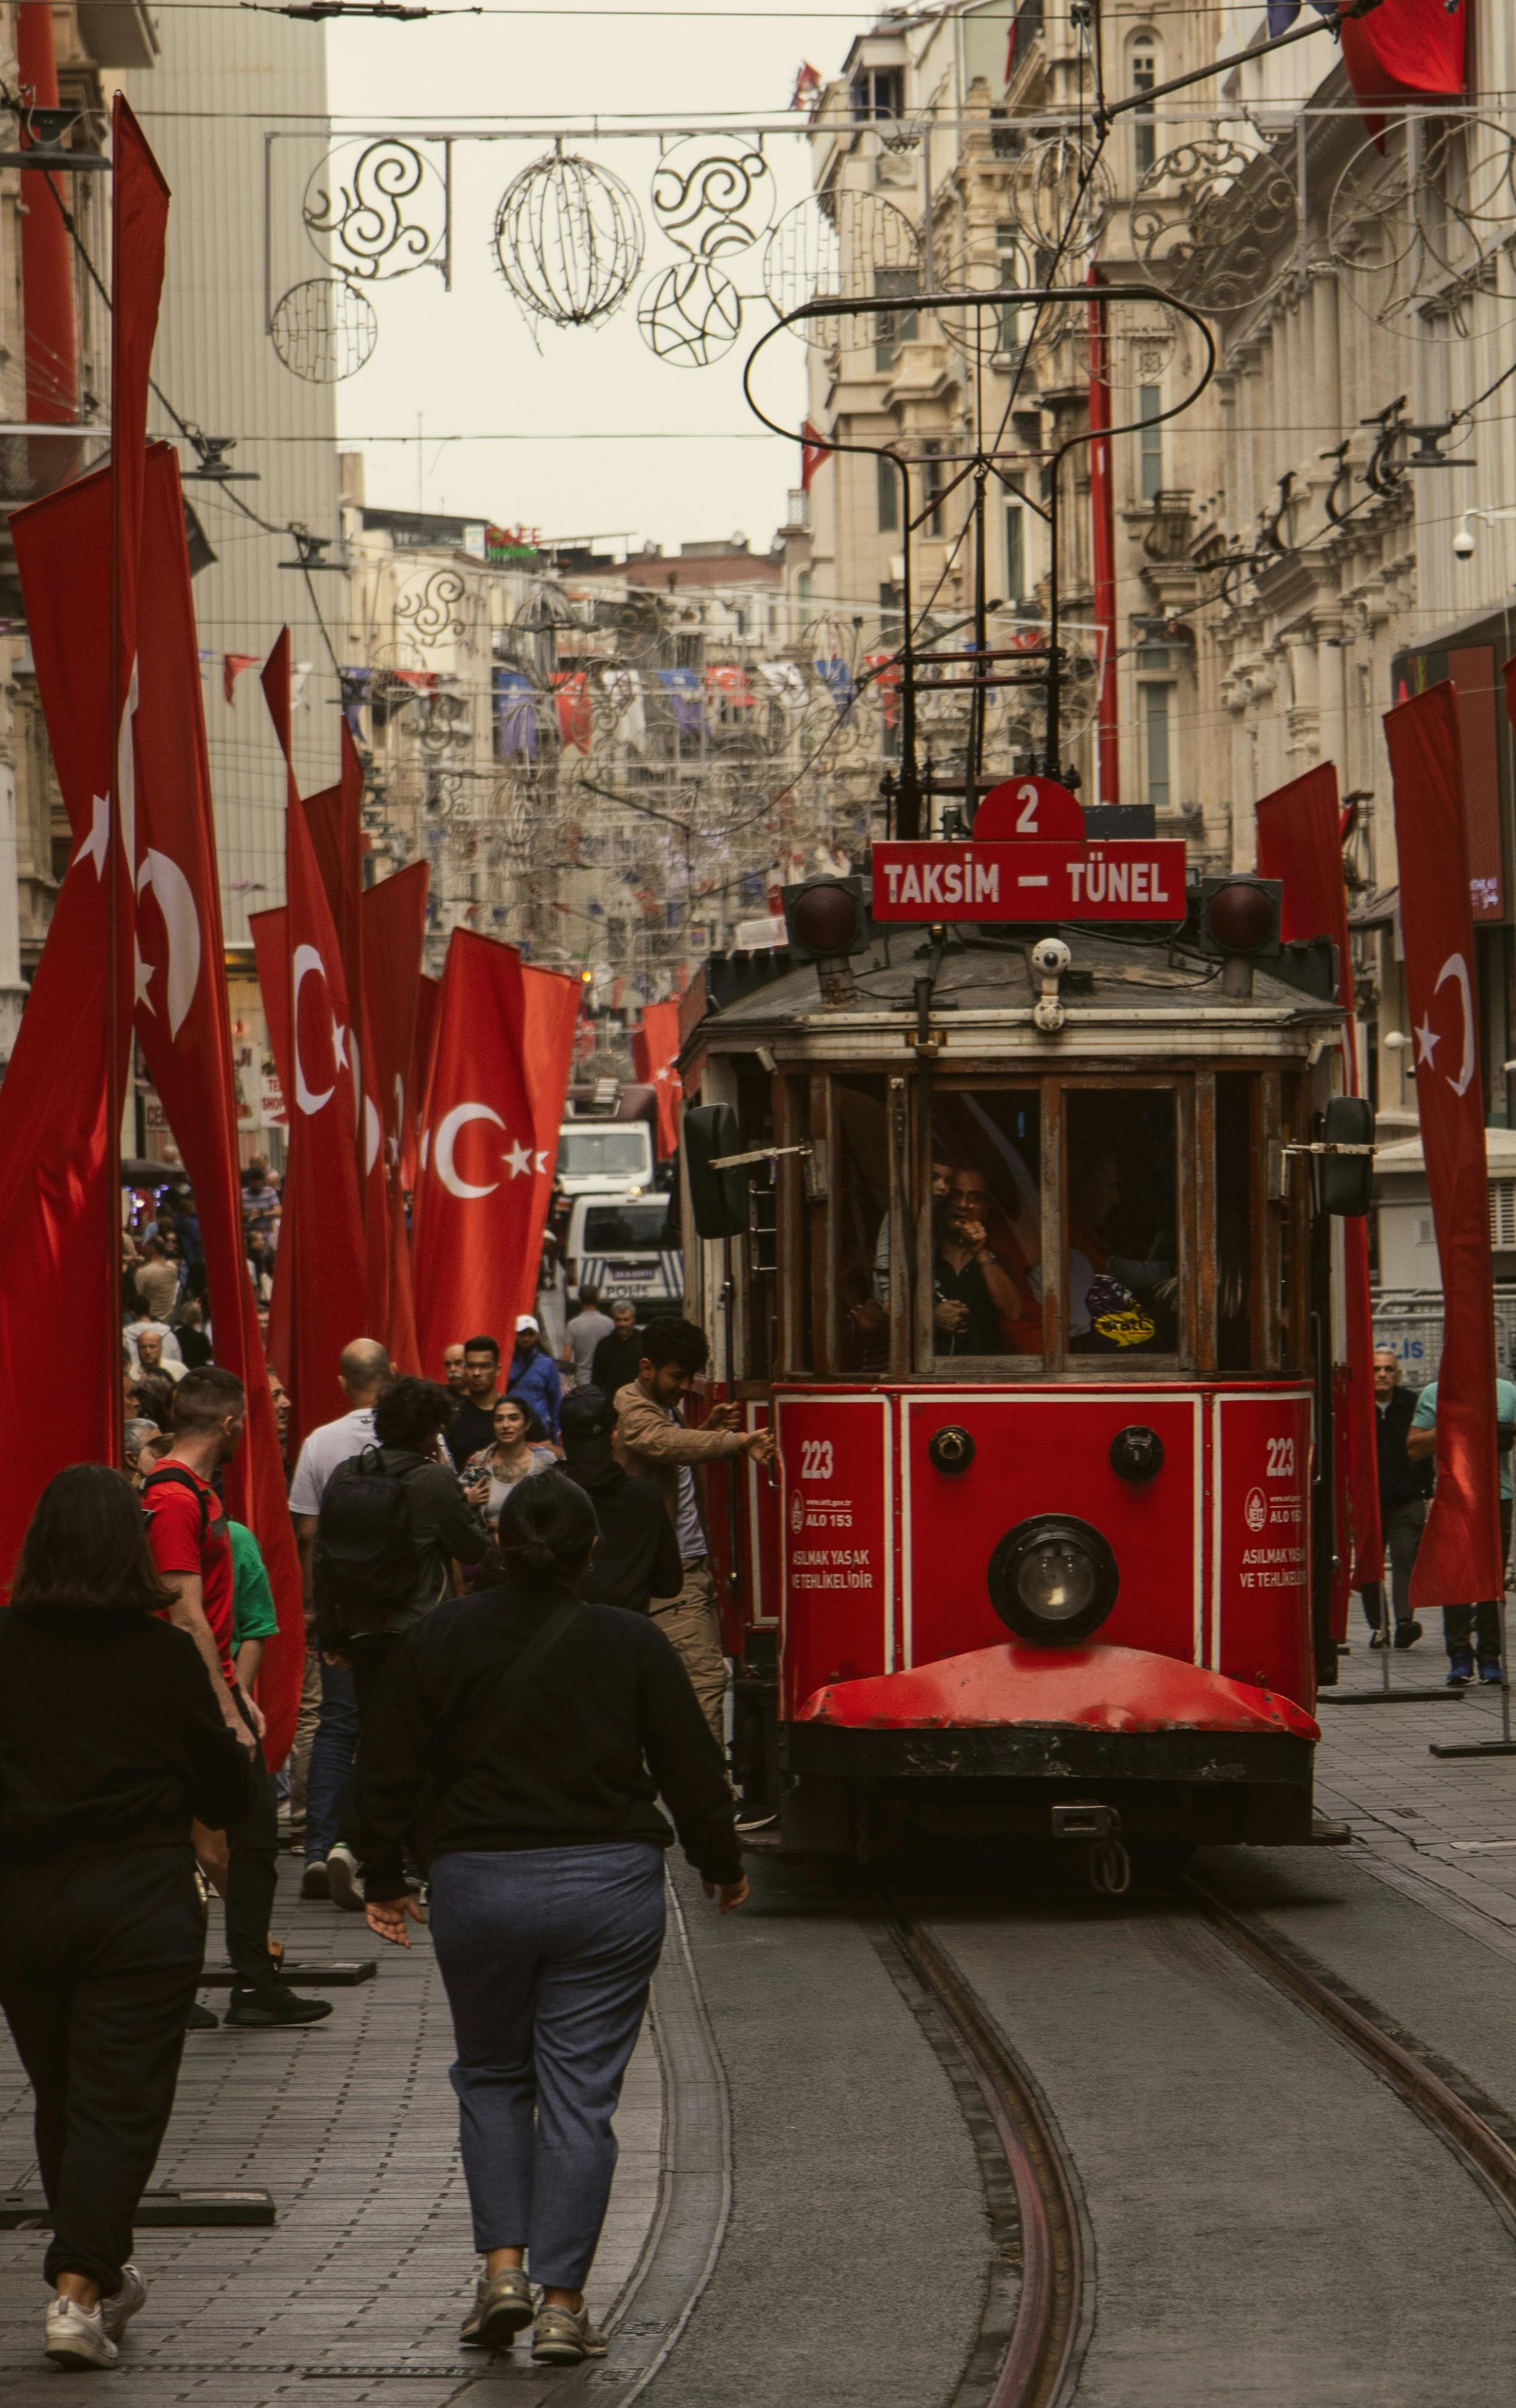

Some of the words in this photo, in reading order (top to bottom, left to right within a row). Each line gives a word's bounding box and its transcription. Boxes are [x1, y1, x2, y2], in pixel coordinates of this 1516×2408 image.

[1015, 784, 1038, 833] 2
[884, 853, 999, 903] TAKSİM
[1066, 852, 1168, 902] TÜNEL
[801, 1440, 834, 1480] 223
[1267, 1437, 1295, 1477] 223
[829, 1514, 853, 1528] 153
[1240, 1572, 1255, 1588] VE
